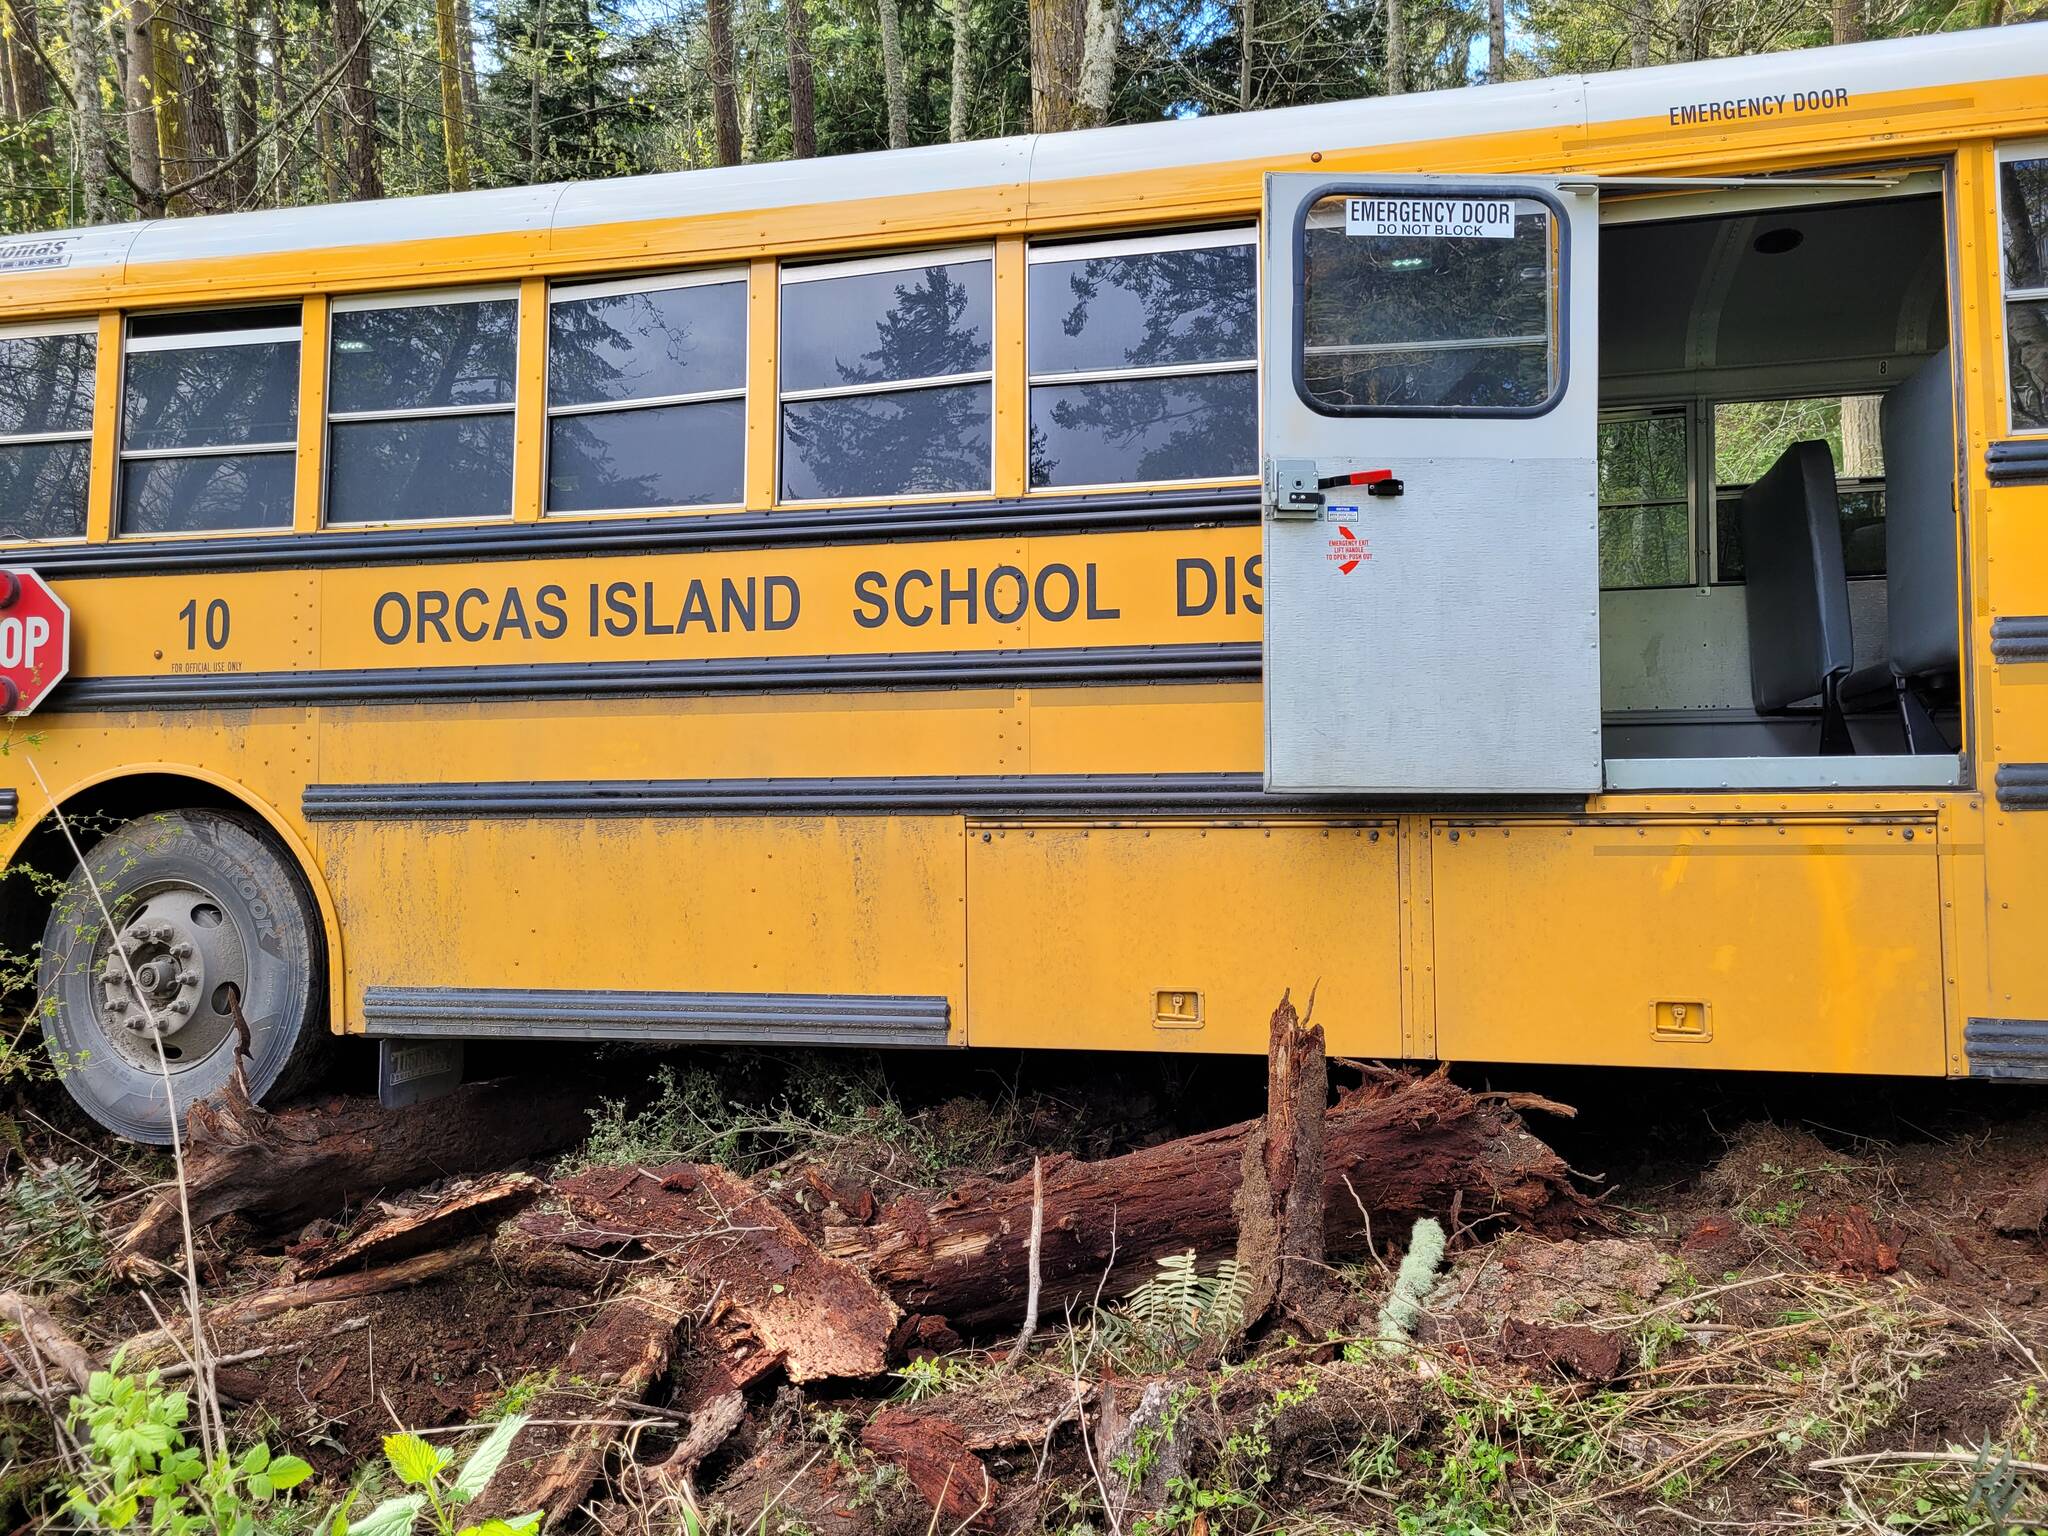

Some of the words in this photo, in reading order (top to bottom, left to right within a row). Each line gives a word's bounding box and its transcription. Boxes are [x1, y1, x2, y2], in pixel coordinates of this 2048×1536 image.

[1670, 94, 1786, 126] EMERGENCY
[1793, 87, 1848, 112] DOOR
[1351, 201, 1456, 223] EMERGENCY
[1462, 202, 1510, 224] DOOR
[1377, 224, 1397, 235] DO
[1401, 224, 1431, 236] NOT
[1434, 225, 1483, 236] BLOCK
[373, 585, 568, 646] ORCAS
[589, 575, 801, 637] ISLAND
[853, 563, 1121, 629] SCHOOL
[179, 598, 231, 650] 10
[171, 663, 183, 673] FOR
[185, 662, 211, 673] OFFICIAL
[213, 662, 225, 672] USE
[227, 661, 243, 672] ONLY
